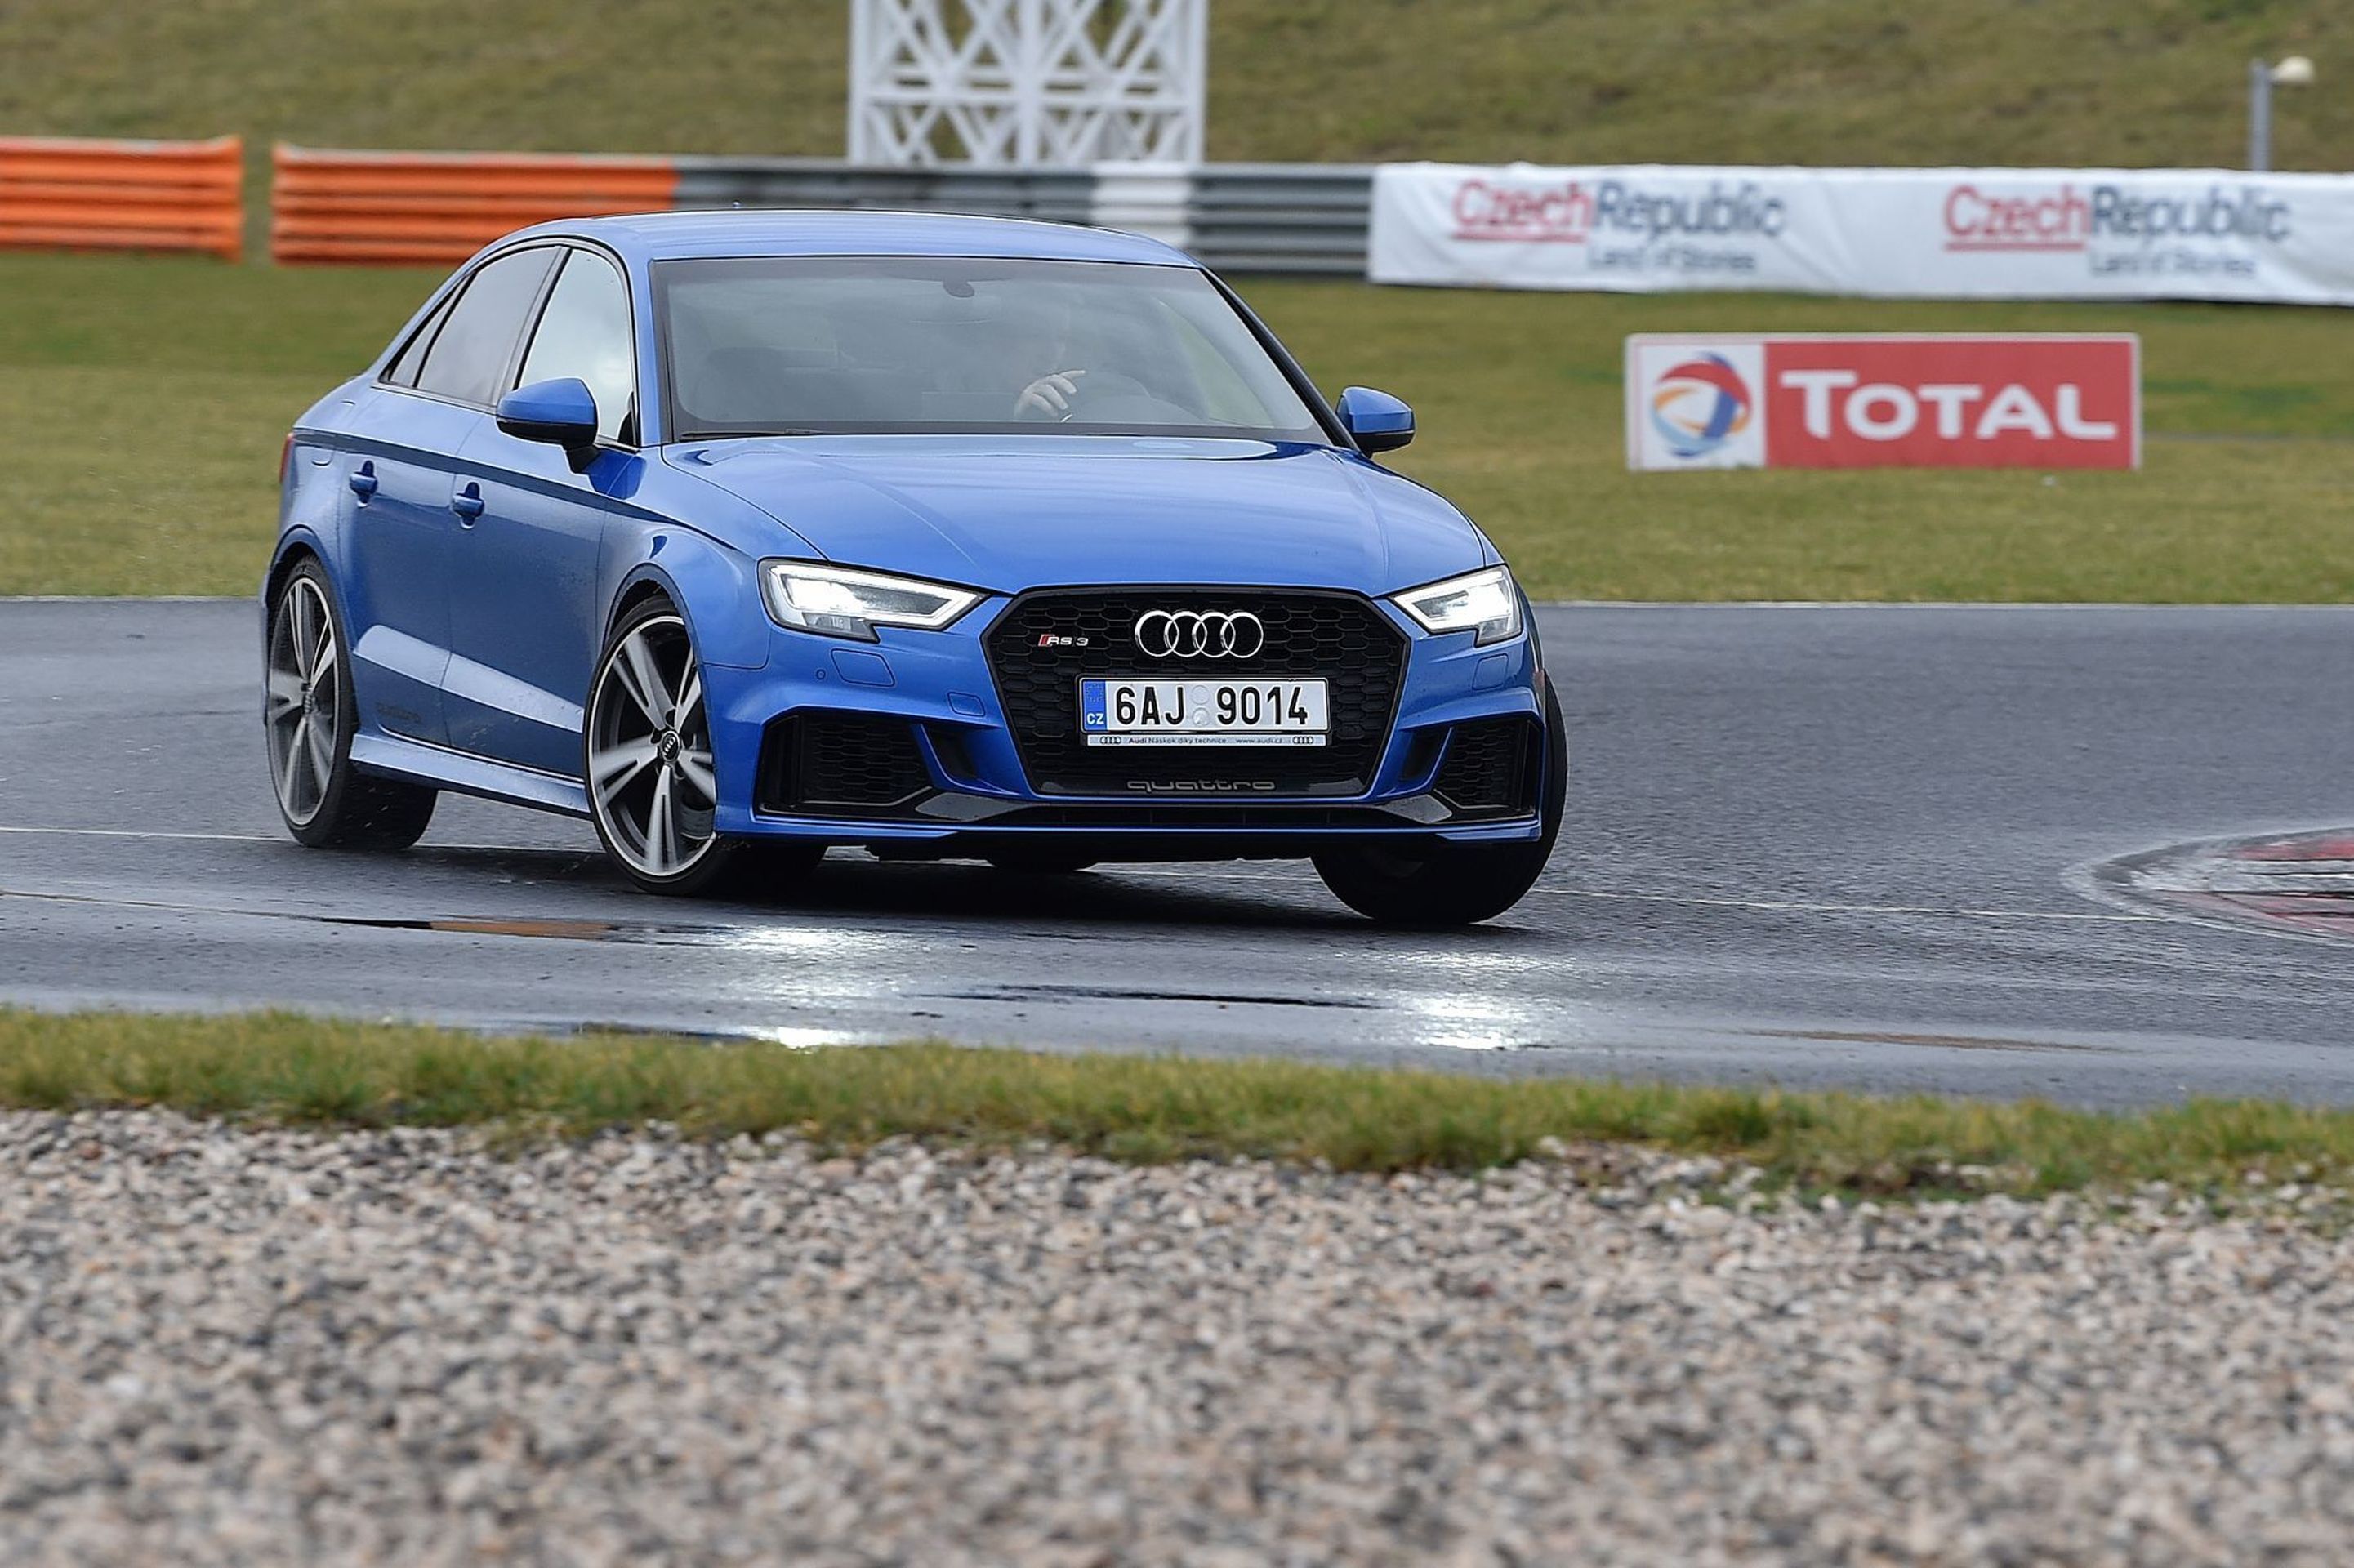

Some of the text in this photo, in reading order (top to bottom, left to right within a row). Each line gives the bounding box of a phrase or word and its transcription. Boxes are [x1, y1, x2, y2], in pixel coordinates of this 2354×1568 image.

[1451, 179, 1786, 241] Czech Republic
[1943, 184, 2289, 244] Czech Republic
[1780, 370, 2117, 439] TOTAL
[1086, 713, 1104, 724] CZ
[1115, 686, 1308, 725] 6AJ 9014
[1127, 779, 1275, 792] quattro
